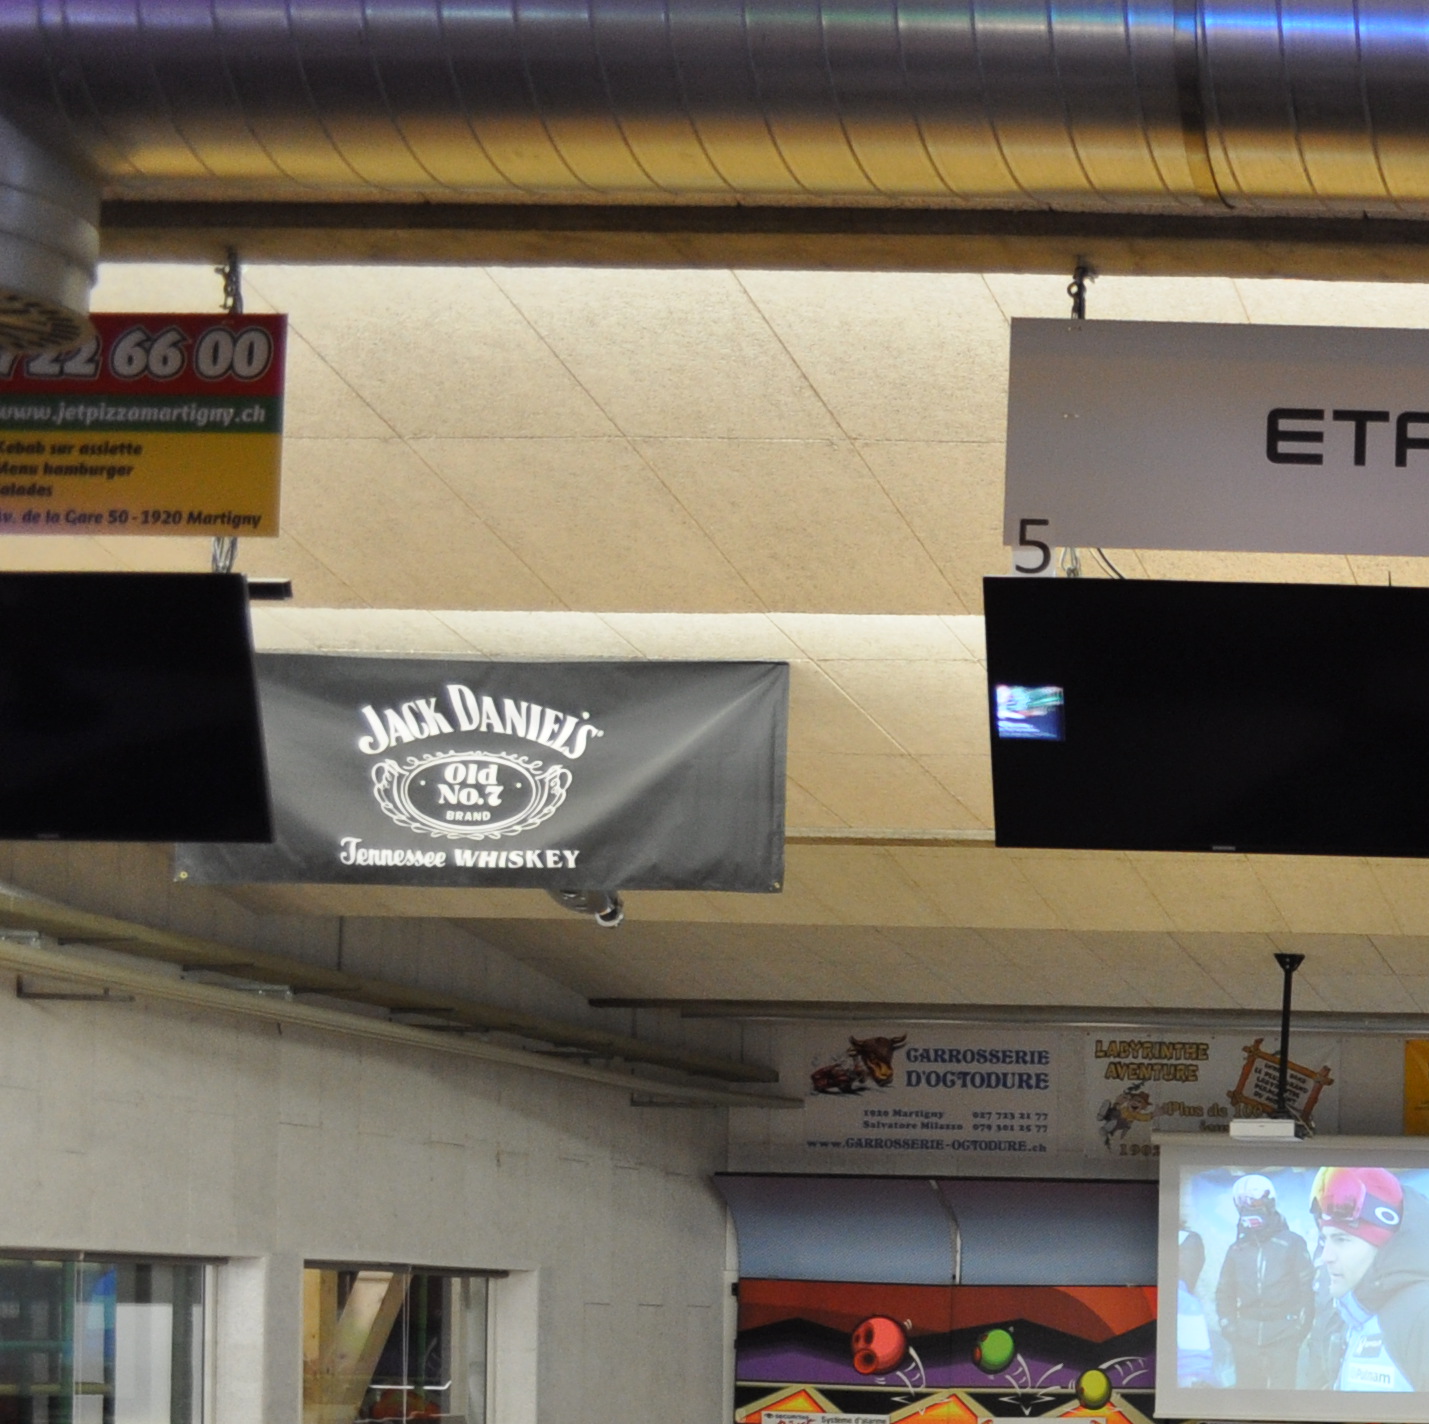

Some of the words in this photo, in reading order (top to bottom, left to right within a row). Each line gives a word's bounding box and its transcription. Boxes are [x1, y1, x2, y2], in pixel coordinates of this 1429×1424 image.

[111, 326, 187, 380] 66
[196, 326, 272, 380] 00
[65, 510, 103, 524] Gare
[108, 510, 129, 523] 50
[142, 510, 182, 525] 1920
[187, 511, 261, 528] Martigny
[1015, 518, 1052, 576] 5
[358, 697, 454, 755] JACK
[444, 763, 498, 785] Old
[437, 784, 504, 806] No.7
[446, 810, 491, 821] BRAND
[340, 837, 446, 868] Tennessee
[454, 849, 580, 869] WHISKEY
[1095, 1039, 1209, 1061] LABYRINTHE
[1104, 1062, 1198, 1082] AVENTURE
